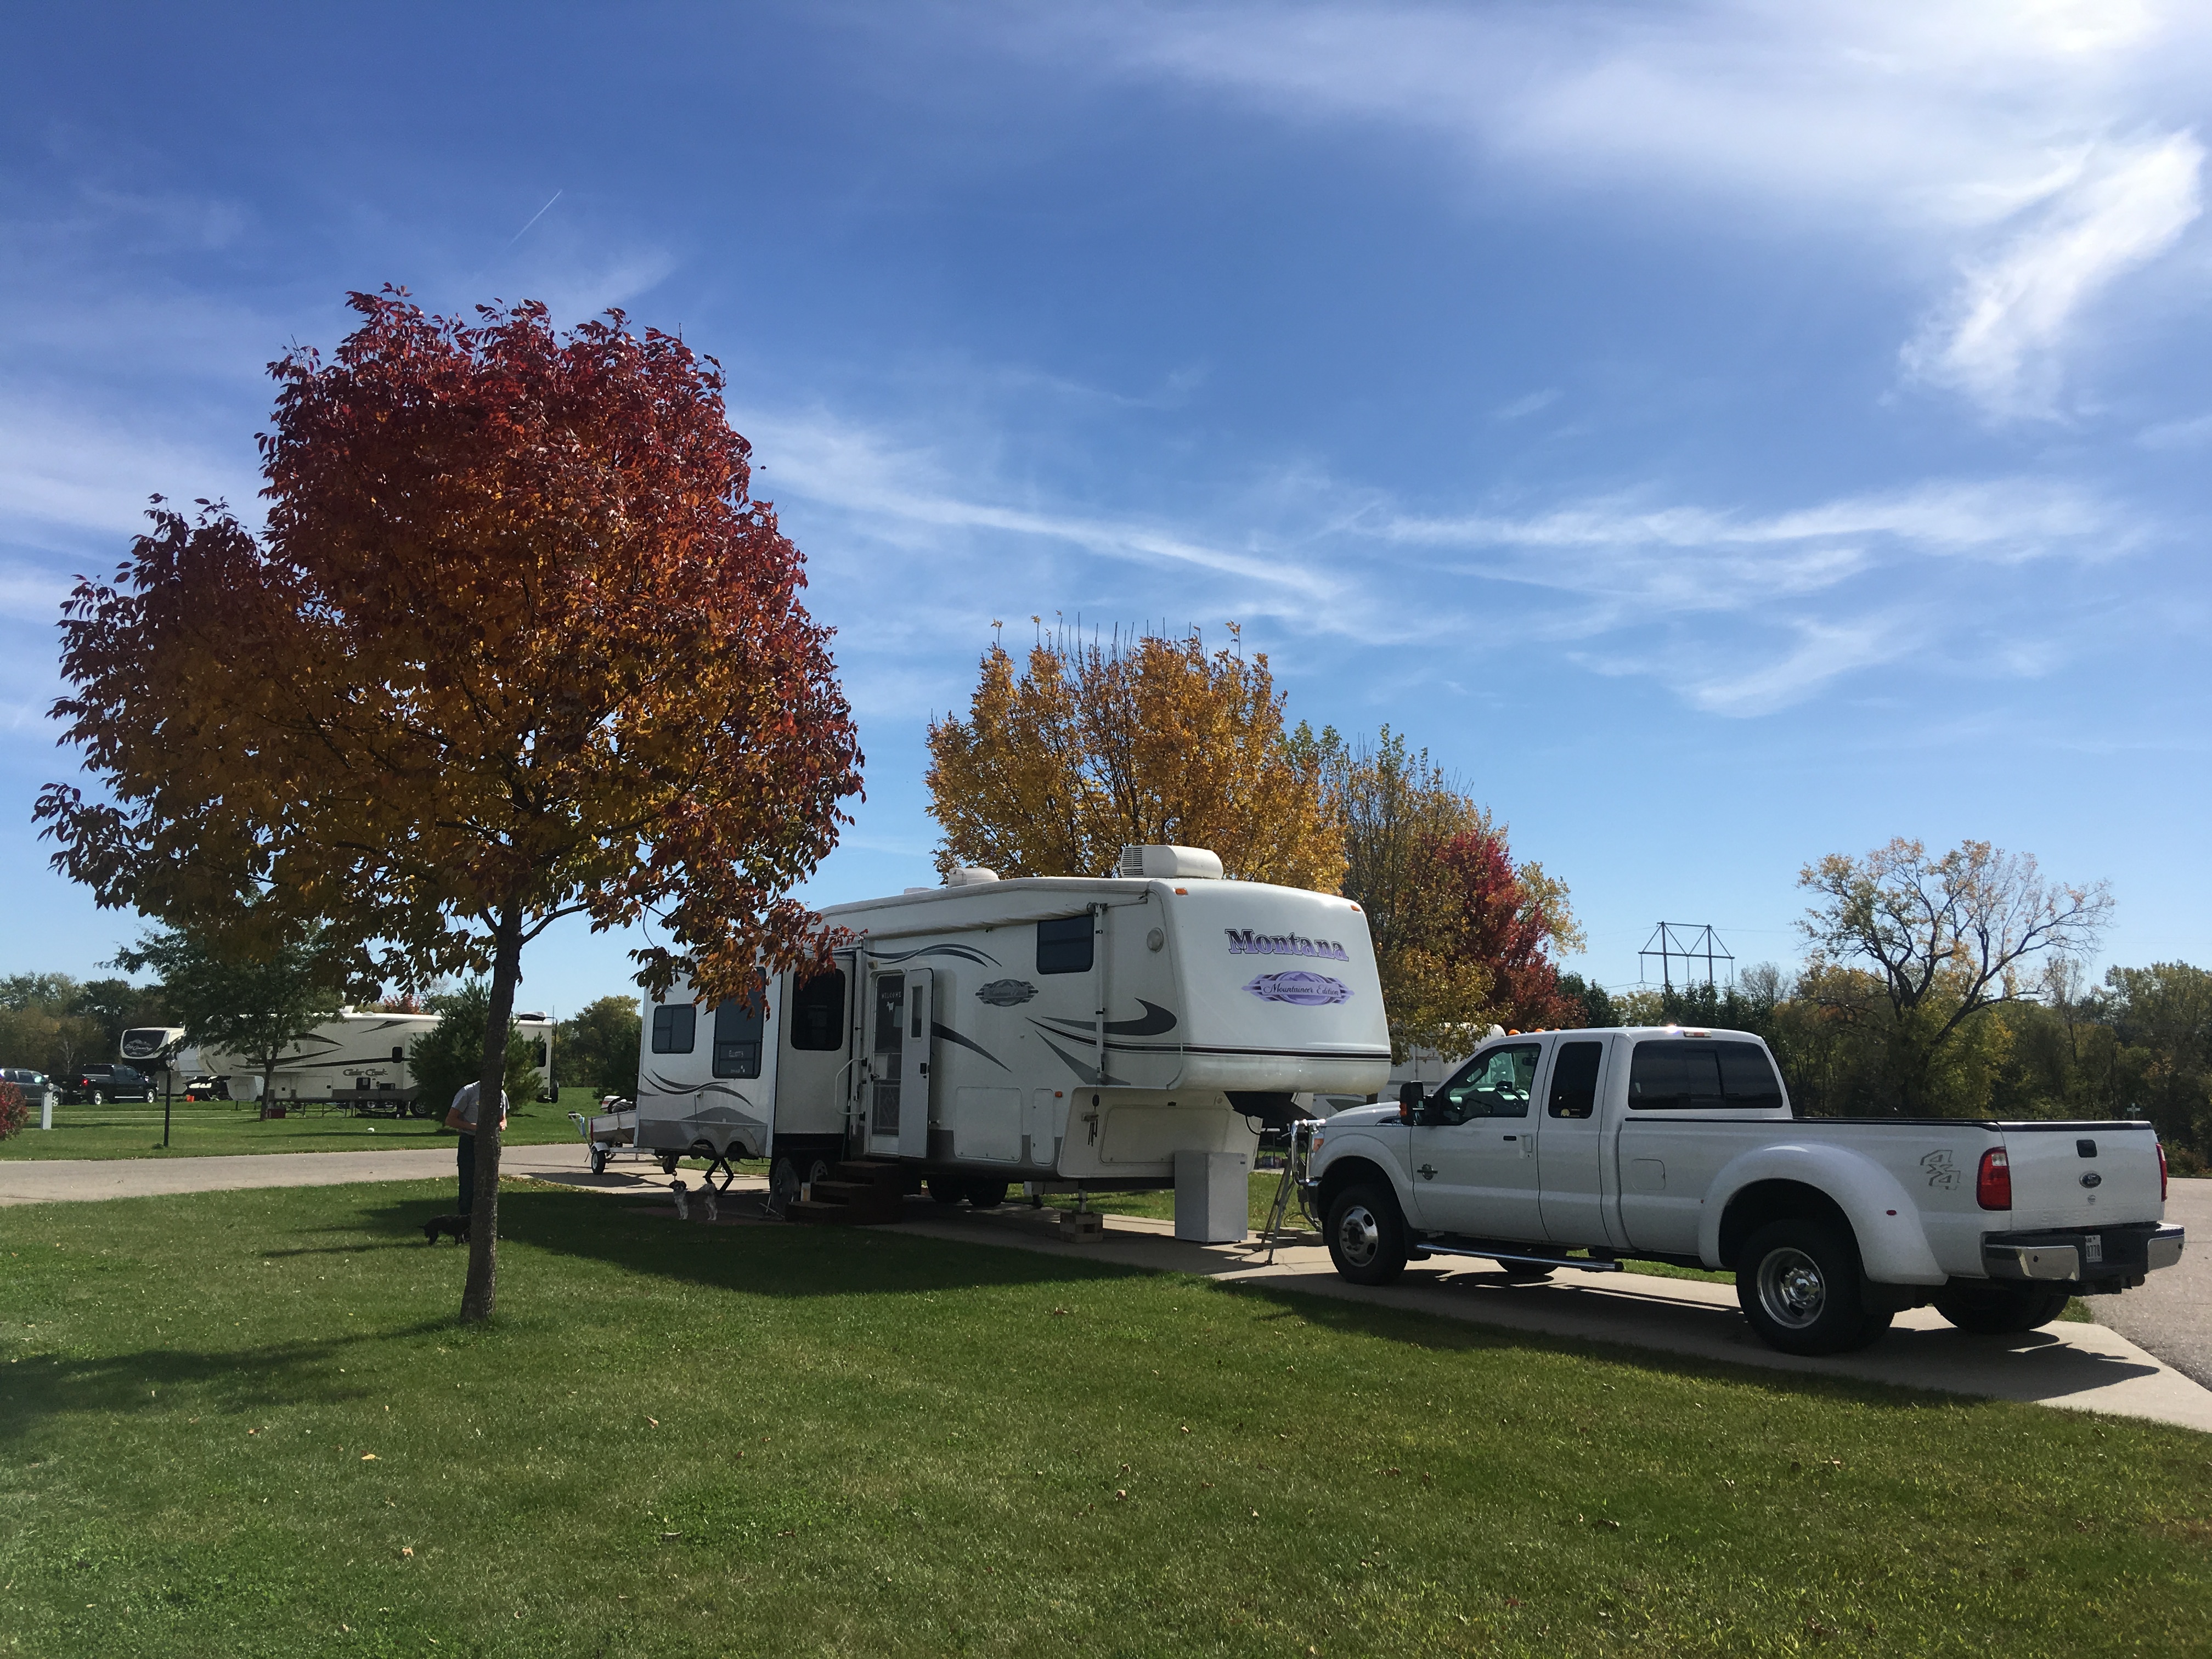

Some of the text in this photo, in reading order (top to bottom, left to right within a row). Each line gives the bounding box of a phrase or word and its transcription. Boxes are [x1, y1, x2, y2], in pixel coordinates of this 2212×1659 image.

[1224, 929, 1349, 961] Montana
[1263, 983, 1339, 996] Mountaineer Edition
